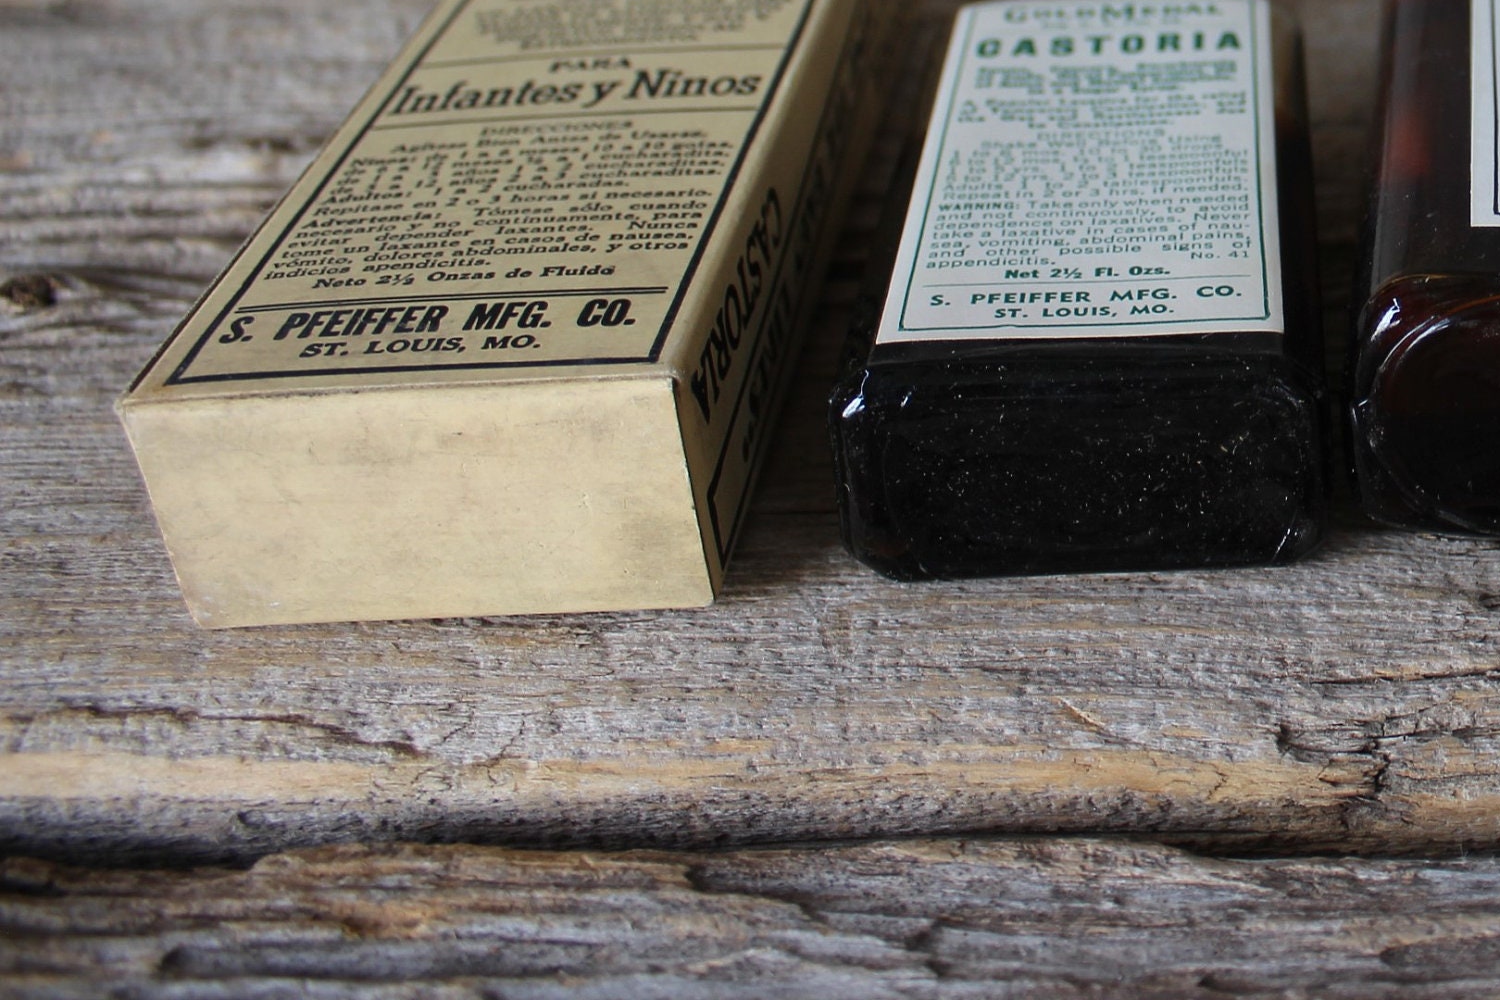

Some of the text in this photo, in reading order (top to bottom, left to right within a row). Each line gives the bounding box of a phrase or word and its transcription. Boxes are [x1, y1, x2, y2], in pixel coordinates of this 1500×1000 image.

[976, 30, 1242, 59] CASTORIA
[388, 68, 762, 115] Infantes y Ninos
[934, 220, 1053, 230] dependence
[1193, 212, 1250, 221] Never
[936, 211, 972, 222] and
[982, 211, 1013, 220] not
[1167, 206, 1186, 214] to
[1198, 202, 1249, 212] avoid
[933, 230, 974, 240] take
[1001, 228, 1076, 237] laxative
[1086, 226, 1104, 235] in
[1113, 225, 1169, 234] cases
[1178, 222, 1197, 232] of
[1079, 234, 1184, 245] abdominal
[281, 247, 335, 259] tome
[343, 245, 370, 254] un
[378, 240, 461, 252] laxante
[469, 238, 496, 246] en
[504, 235, 566, 245] casos
[574, 232, 601, 242] de
[363, 250, 445, 262] dolores
[605, 243, 623, 253] y
[628, 241, 689, 251] otros
[928, 239, 1252, 259] and other possible signs of
[1228, 250, 1249, 258] 41
[263, 266, 351, 280] indicios
[311, 277, 367, 289] Neto
[426, 271, 496, 282] Onzas
[504, 267, 533, 279] de
[1004, 269, 1040, 279] Net
[1094, 267, 1120, 277] Fl.
[1128, 265, 1171, 276] Ozs.
[930, 285, 1242, 306] S. PFEIFFER MFG. CO.
[691, 187, 782, 425] CASTORIA
[994, 303, 1174, 319] ST. LOUIS, MO.
[218, 298, 636, 344] S. PFEIFFER MFG. CO.
[298, 334, 541, 358] ST. LOUIS, MO.
